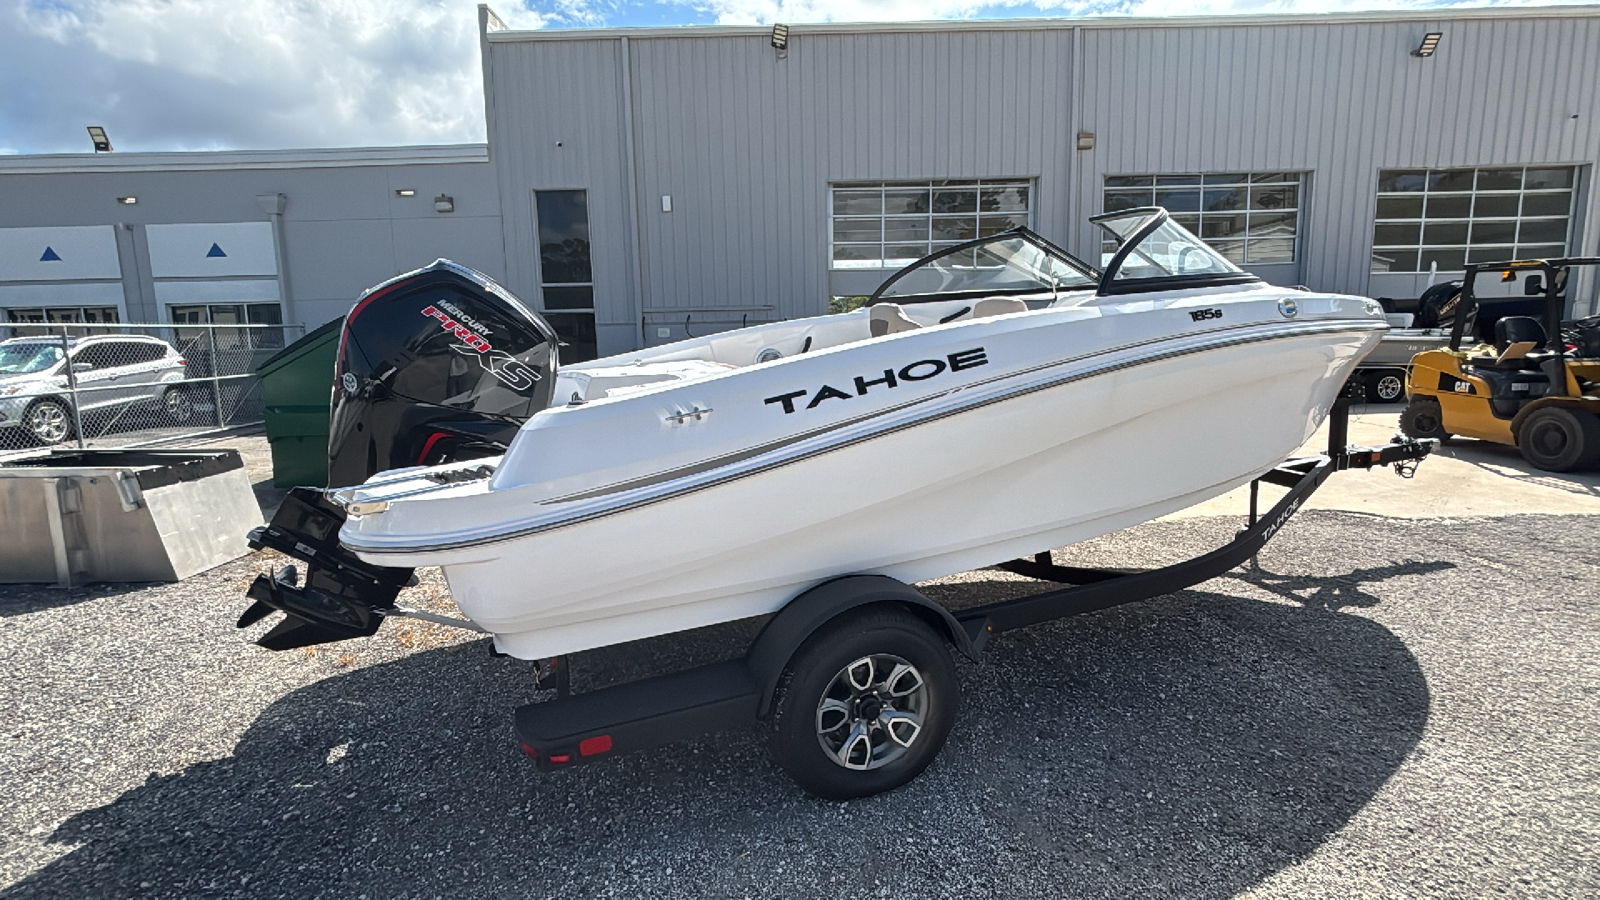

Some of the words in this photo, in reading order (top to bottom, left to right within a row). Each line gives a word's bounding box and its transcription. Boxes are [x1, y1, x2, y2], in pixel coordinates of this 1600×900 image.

[421, 305, 492, 354] PRO
[437, 299, 493, 336] MERCURY
[449, 343, 542, 391] XS
[764, 347, 989, 414] TAHOE
[1454, 381, 1471, 393] CAT
[1262, 497, 1299, 540] TAHOE
